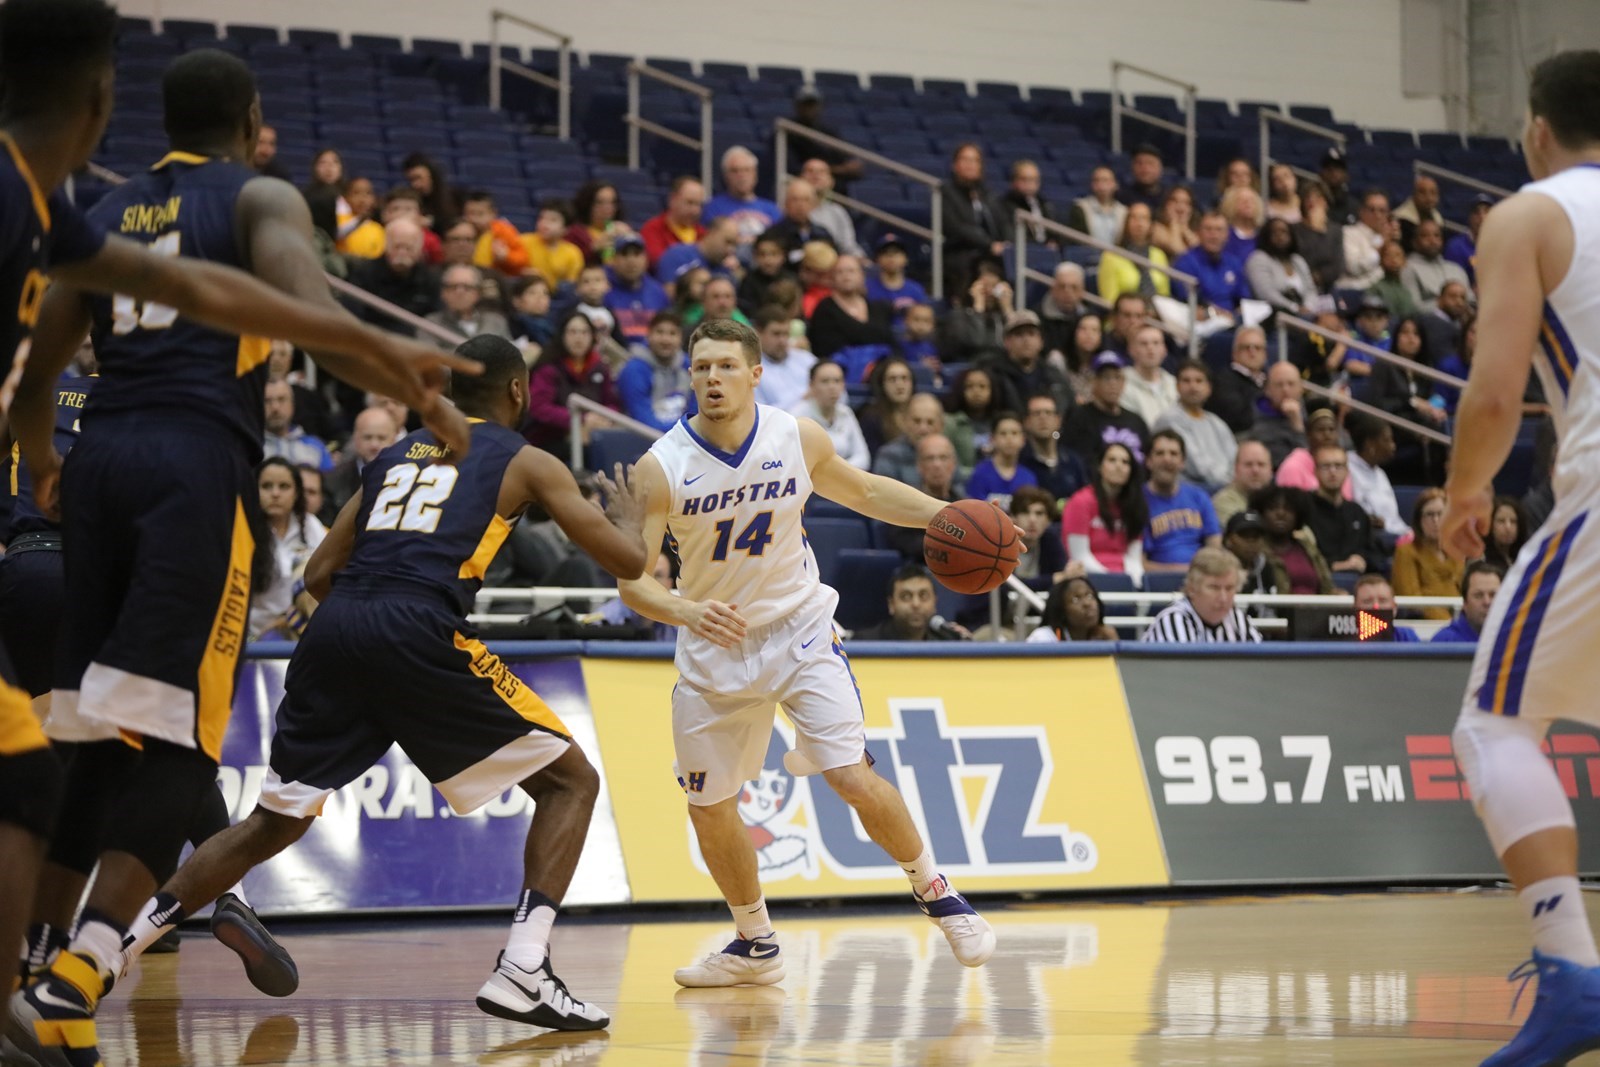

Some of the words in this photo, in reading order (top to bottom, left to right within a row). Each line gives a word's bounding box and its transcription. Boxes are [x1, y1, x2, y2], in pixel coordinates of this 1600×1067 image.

[57, 391, 87, 409] TRE
[761, 460, 783, 470] CAA
[365, 462, 459, 534] 22
[682, 477, 797, 516] HOFSTRA
[710, 509, 775, 562] 14
[213, 567, 248, 658] EAGLES
[689, 771, 707, 793] H
[1155, 735, 1332, 804] 98.7
[1343, 765, 1405, 803] FM
